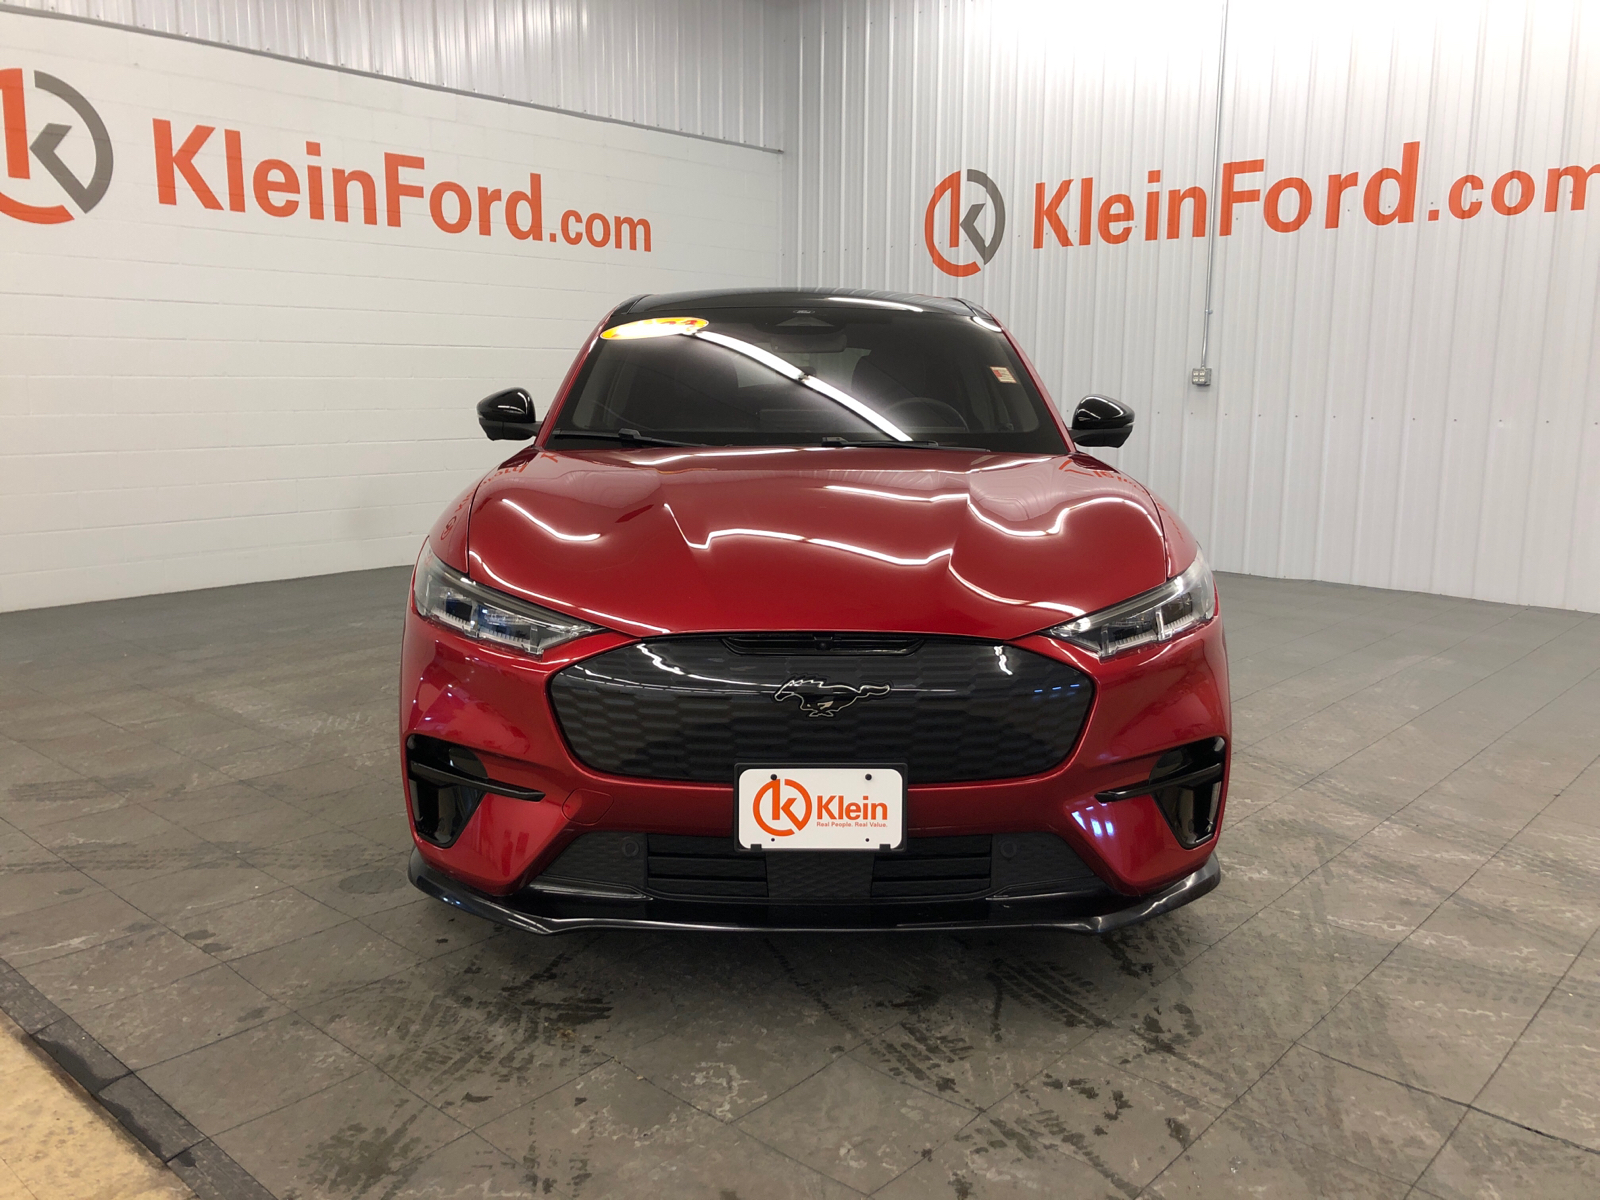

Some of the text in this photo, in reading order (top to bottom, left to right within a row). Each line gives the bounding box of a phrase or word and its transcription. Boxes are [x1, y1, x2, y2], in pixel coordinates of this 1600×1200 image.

[152, 118, 652, 253] KleinFord.com
[1032, 141, 1600, 250] KleinFord.com
[816, 795, 889, 821] Klein
